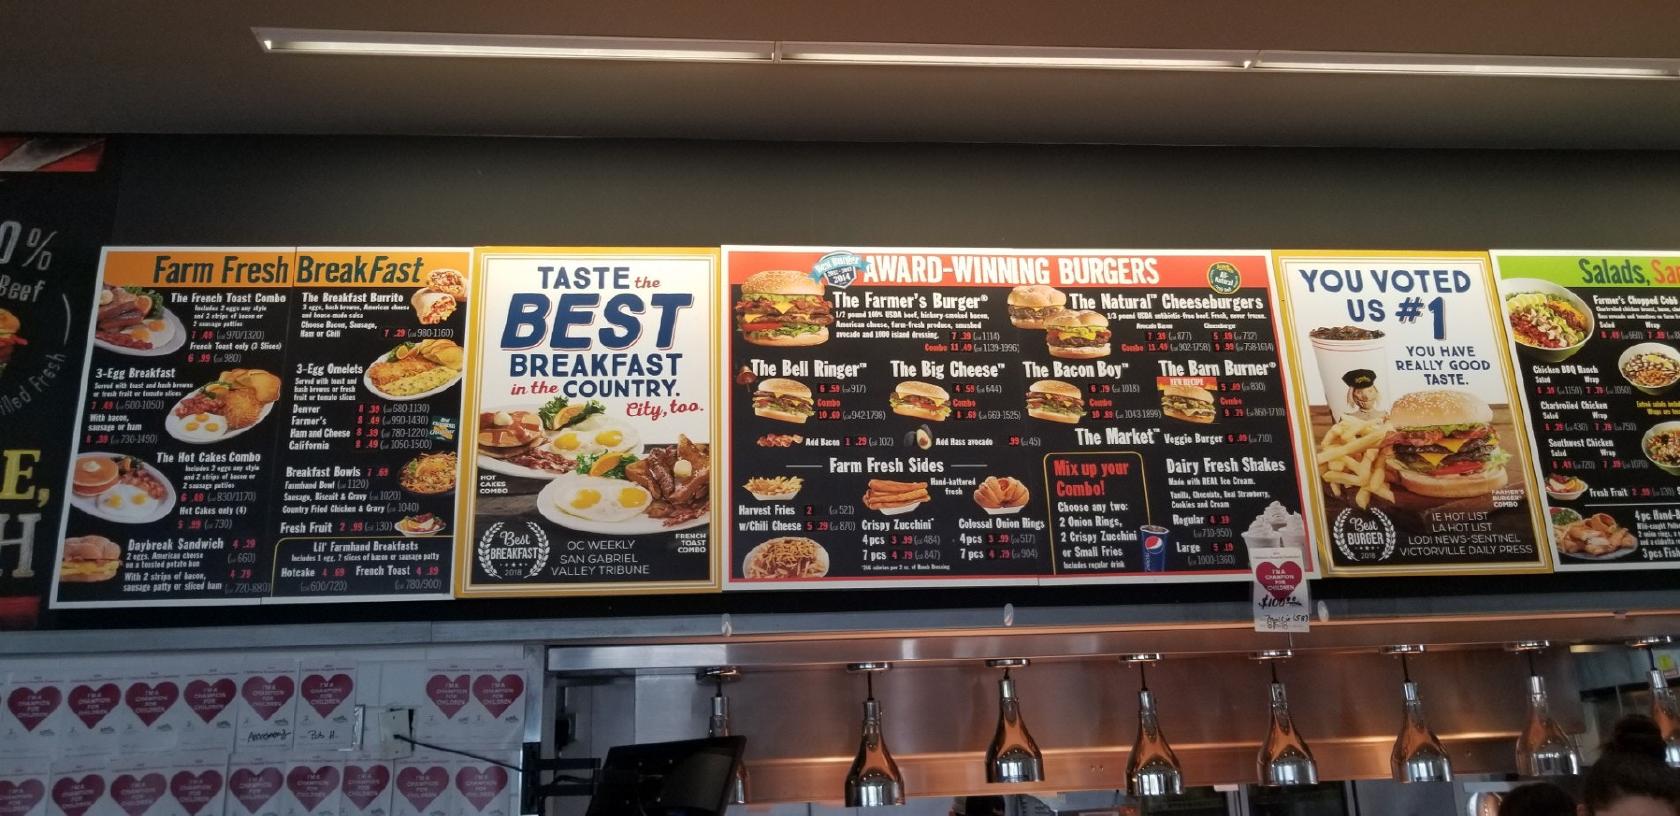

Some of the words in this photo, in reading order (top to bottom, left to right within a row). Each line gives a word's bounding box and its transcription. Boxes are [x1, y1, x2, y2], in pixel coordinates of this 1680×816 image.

[153, 256, 214, 283] Farm
[221, 256, 289, 284] Fresh
[864, 255, 1050, 285] AWARD-WINNING
[1058, 257, 1160, 285] BURGERS
[1578, 258, 1650, 285] Salads,
[538, 267, 630, 289] TASTE
[634, 277, 660, 288] the
[1299, 270, 1364, 293] YOU
[1370, 270, 1471, 293] VOTED
[171, 293, 188, 303] The
[191, 293, 222, 303] French
[226, 293, 251, 303] Toast
[255, 293, 286, 303] Combo
[302, 293, 318, 302] The
[323, 293, 367, 302] Breakfast
[370, 293, 403, 302] Burrito
[833, 292, 859, 308] The
[865, 292, 927, 308] Farmer's
[1069, 293, 1095, 309] The
[1162, 293, 1263, 311] Cheeseburgers
[1347, 299, 1385, 322] US
[500, 293, 694, 351] BEST
[925, 344, 947, 352] Combo
[1406, 346, 1435, 357] YOU
[1440, 346, 1475, 356] HAVE
[296, 364, 324, 375] 3-Egg
[327, 364, 363, 374] Omelets
[510, 354, 683, 377] BREAKFAST
[751, 359, 776, 376] The
[782, 360, 808, 377] Bell
[890, 360, 917, 377] The
[921, 361, 944, 379] Big
[1023, 361, 1049, 378] The
[1054, 362, 1093, 378] Bacon
[1158, 360, 1184, 376] The
[1188, 360, 1220, 376] Barn
[1396, 360, 1443, 371] REALLY
[1449, 360, 1490, 371] GOOD
[1533, 365, 1560, 374] Chicken
[1562, 365, 1576, 375] BBQ
[1578, 366, 1598, 374] Ranch
[95, 369, 125, 379] 3-Egg
[129, 368, 176, 379] Breakfast
[1424, 374, 1469, 385] TASTE.
[511, 384, 528, 395] in
[531, 381, 559, 394] the
[563, 379, 680, 397] COUNTRY.
[293, 405, 320, 413] Denver
[627, 402, 668, 420] City,
[670, 400, 704, 413] too.
[1581, 401, 1608, 409] Chicken
[292, 417, 327, 425] Farmer's
[290, 429, 308, 438] Ham
[309, 429, 323, 437] and
[324, 429, 350, 438] Cheese
[1075, 428, 1101, 446] The
[1164, 434, 1192, 444] Veggie
[1195, 434, 1223, 444] Burger
[289, 441, 330, 450] California
[936, 437, 948, 446] Add
[950, 437, 966, 446] Hass
[968, 438, 993, 446] avocado
[1548, 439, 1584, 447] Southwest
[1587, 439, 1613, 447] Chicken
[157, 453, 174, 463] The
[178, 453, 194, 462] Hot
[199, 453, 226, 463] Cakes
[229, 453, 261, 463] Combo
[830, 458, 862, 472] Farm
[867, 457, 903, 472] Fresh
[908, 457, 944, 472] Sides
[1054, 460, 1079, 476] Mix
[1082, 461, 1097, 477] up
[1101, 461, 1129, 476] your
[1166, 458, 1199, 475] Dairy
[1204, 457, 1238, 473] Fresh
[1242, 457, 1285, 472] Shakes
[286, 467, 330, 477] Breakfast
[334, 466, 360, 477] Bowls
[1056, 481, 1105, 497] Combo!
[1590, 489, 1609, 497] Fresh
[1611, 488, 1628, 497] Fruit
[283, 505, 309, 514] Country
[331, 504, 356, 512] Chicken
[739, 505, 771, 515] Harvest
[775, 505, 795, 515] Fries
[1058, 502, 1090, 512] Choose
[1094, 503, 1107, 513] any
[1110, 502, 1128, 511] two:
[1173, 515, 1204, 526] Regular
[1432, 513, 1441, 521] IE
[1444, 512, 1466, 520] HOT
[1469, 512, 1487, 520] LIST
[280, 523, 306, 533] Fresh
[310, 522, 332, 533] Fruit
[862, 519, 890, 532] Crispy
[959, 518, 993, 529] Colossal
[996, 518, 1020, 529] Onion
[1022, 518, 1044, 530] Rings
[1350, 518, 1378, 531] Best
[1432, 524, 1447, 532] LA
[1472, 523, 1492, 531] LIST
[500, 531, 530, 545] Best
[1348, 533, 1384, 544] BURGER
[1409, 536, 1433, 545] LODI
[1435, 534, 1520, 544] NEWS-SENTINEL
[128, 539, 174, 550] Daybreak
[178, 539, 224, 550] Sandwich
[567, 541, 584, 550] OC
[587, 540, 635, 550] WEEKLY
[1176, 542, 1200, 553] Large
[491, 548, 539, 559] BREAKFAST
[1401, 546, 1466, 557] VICTORVILLE
[1469, 546, 1496, 555] DAILY
[1500, 545, 1532, 553] PRESS
[560, 555, 585, 564] SAN
[588, 554, 638, 563] GABRIEL
[551, 566, 596, 576] VALLEY
[599, 565, 650, 574] TRIBUNE
